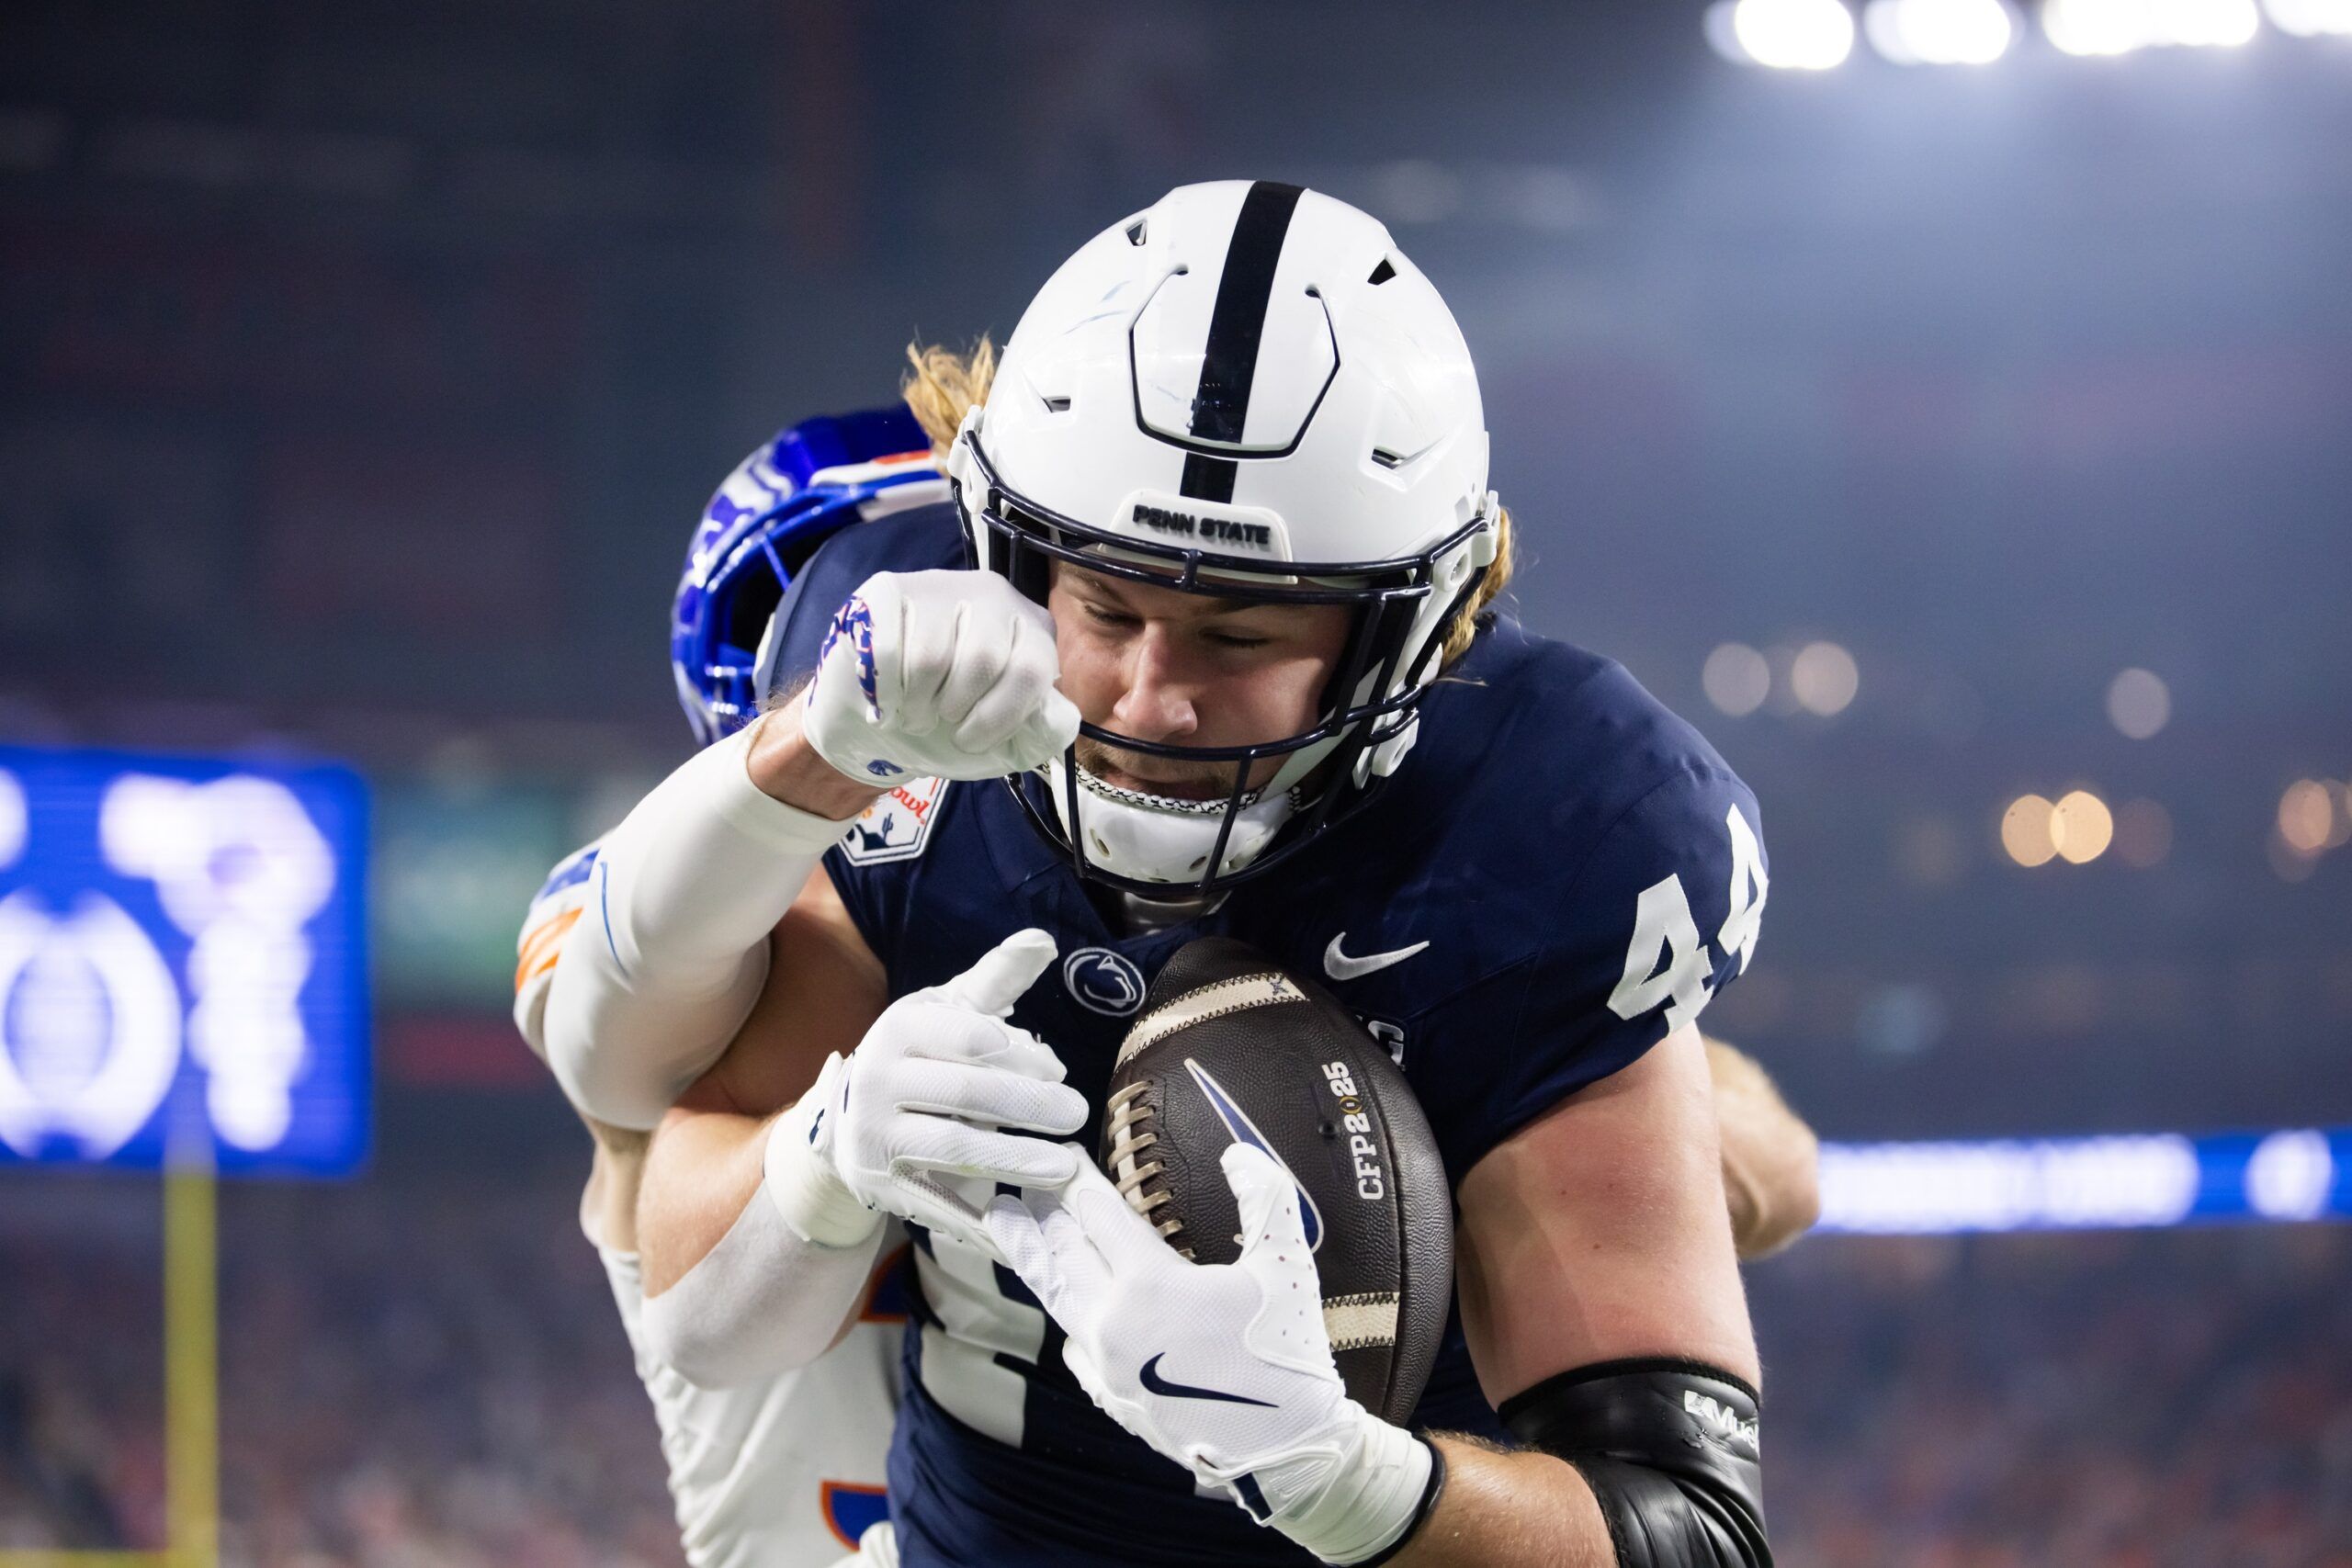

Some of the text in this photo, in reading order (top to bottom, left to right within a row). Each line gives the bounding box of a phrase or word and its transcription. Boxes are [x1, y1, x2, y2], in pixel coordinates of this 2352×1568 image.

[1132, 504, 1271, 544] PENN STATE
[888, 786, 930, 818] owl
[1606, 802, 1770, 1033] 44
